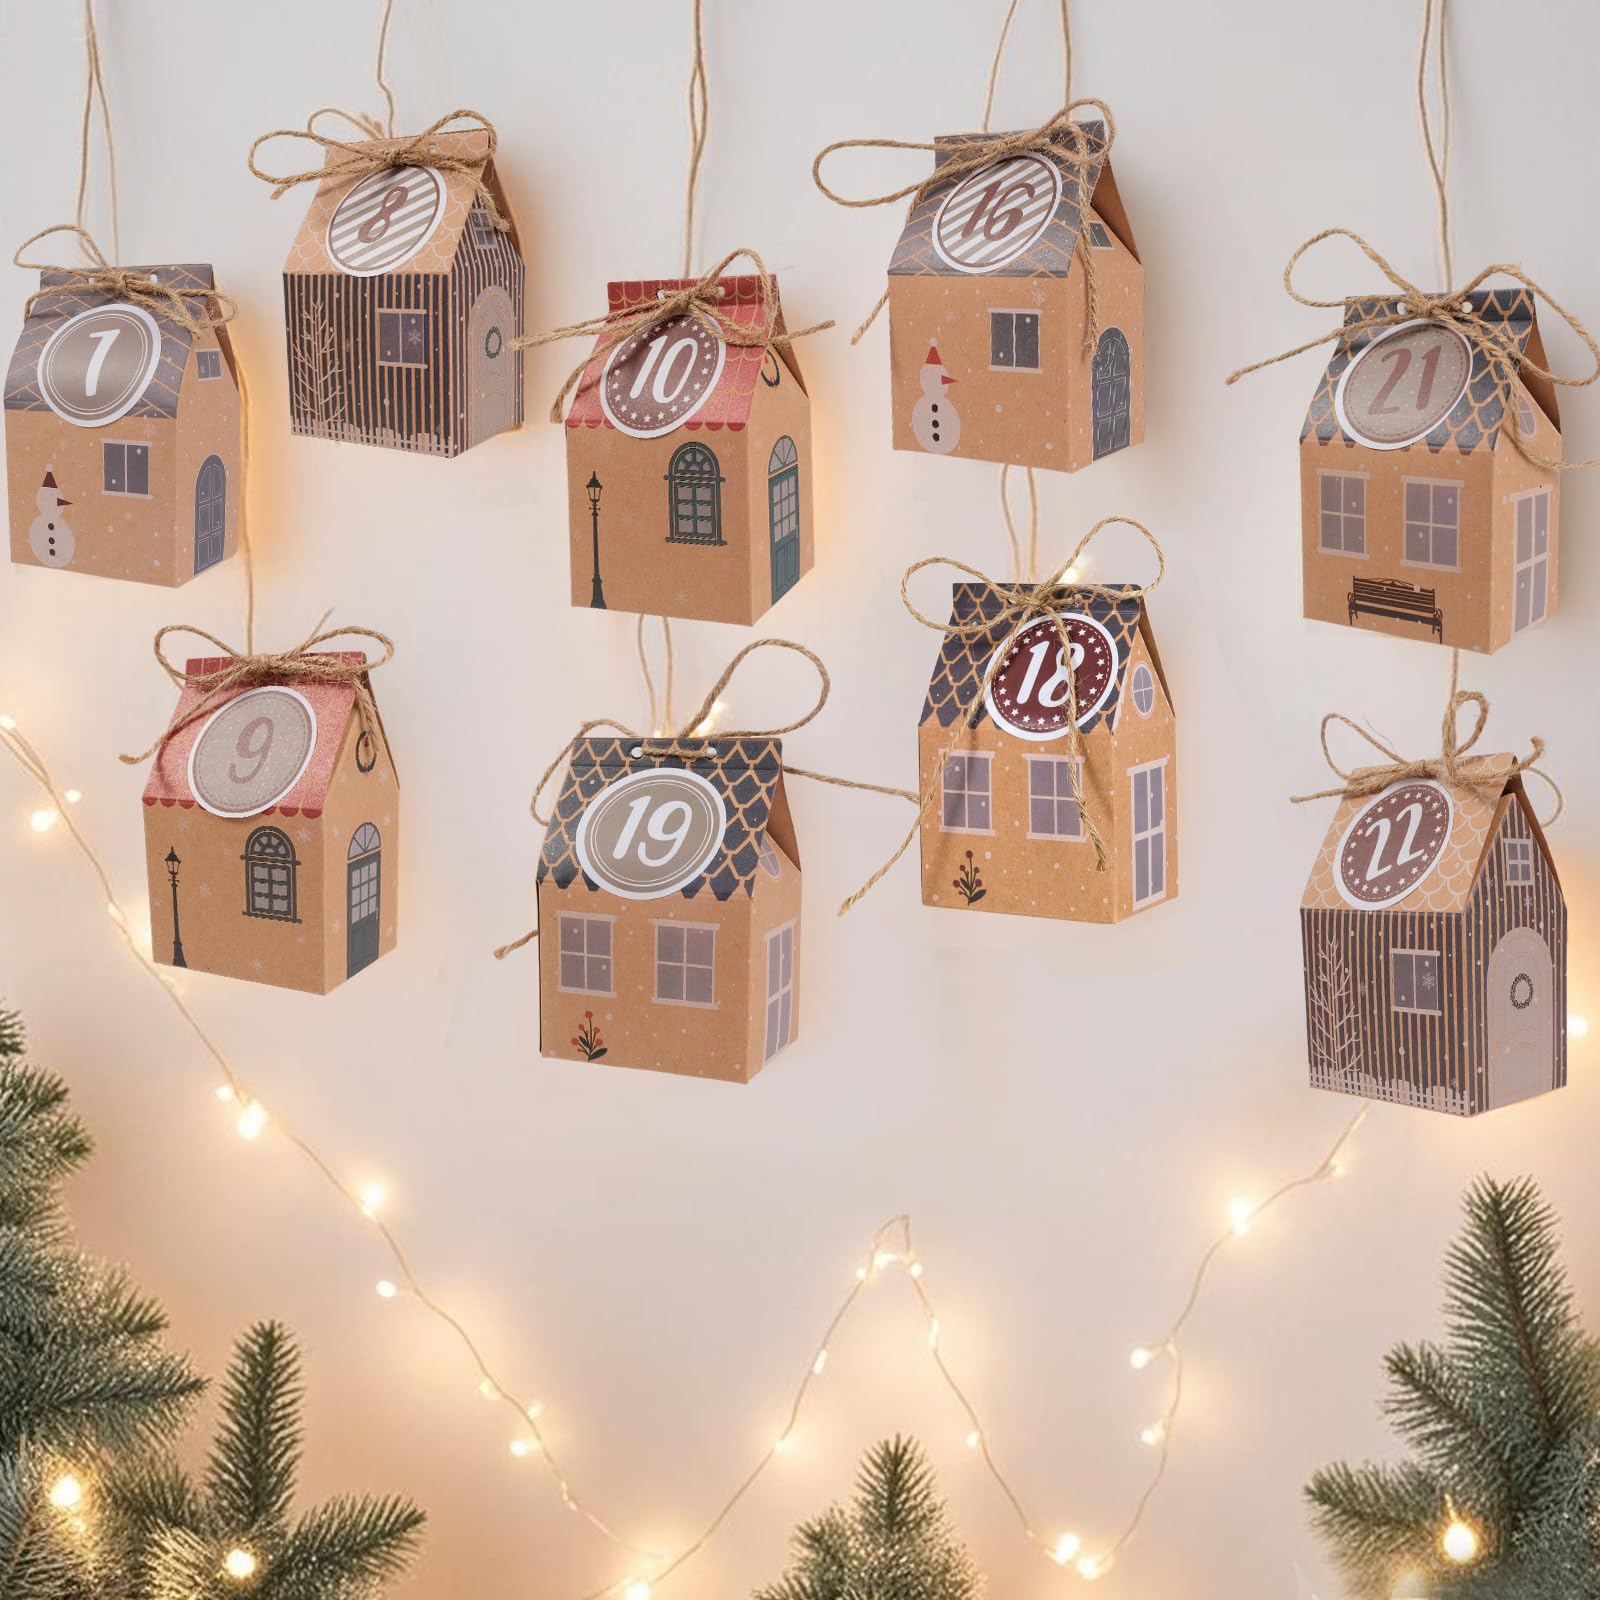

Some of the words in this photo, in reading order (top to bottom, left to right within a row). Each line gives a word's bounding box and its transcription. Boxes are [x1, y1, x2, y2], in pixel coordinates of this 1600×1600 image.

[357, 186, 408, 244] 8
[961, 181, 1035, 241] 16
[85, 328, 121, 397] 7
[629, 334, 699, 405] 10
[1367, 344, 1442, 416] 21
[1016, 640, 1086, 708] 18
[228, 716, 274, 785] 9
[612, 795, 692, 868] 19
[1365, 802, 1425, 882] 22
